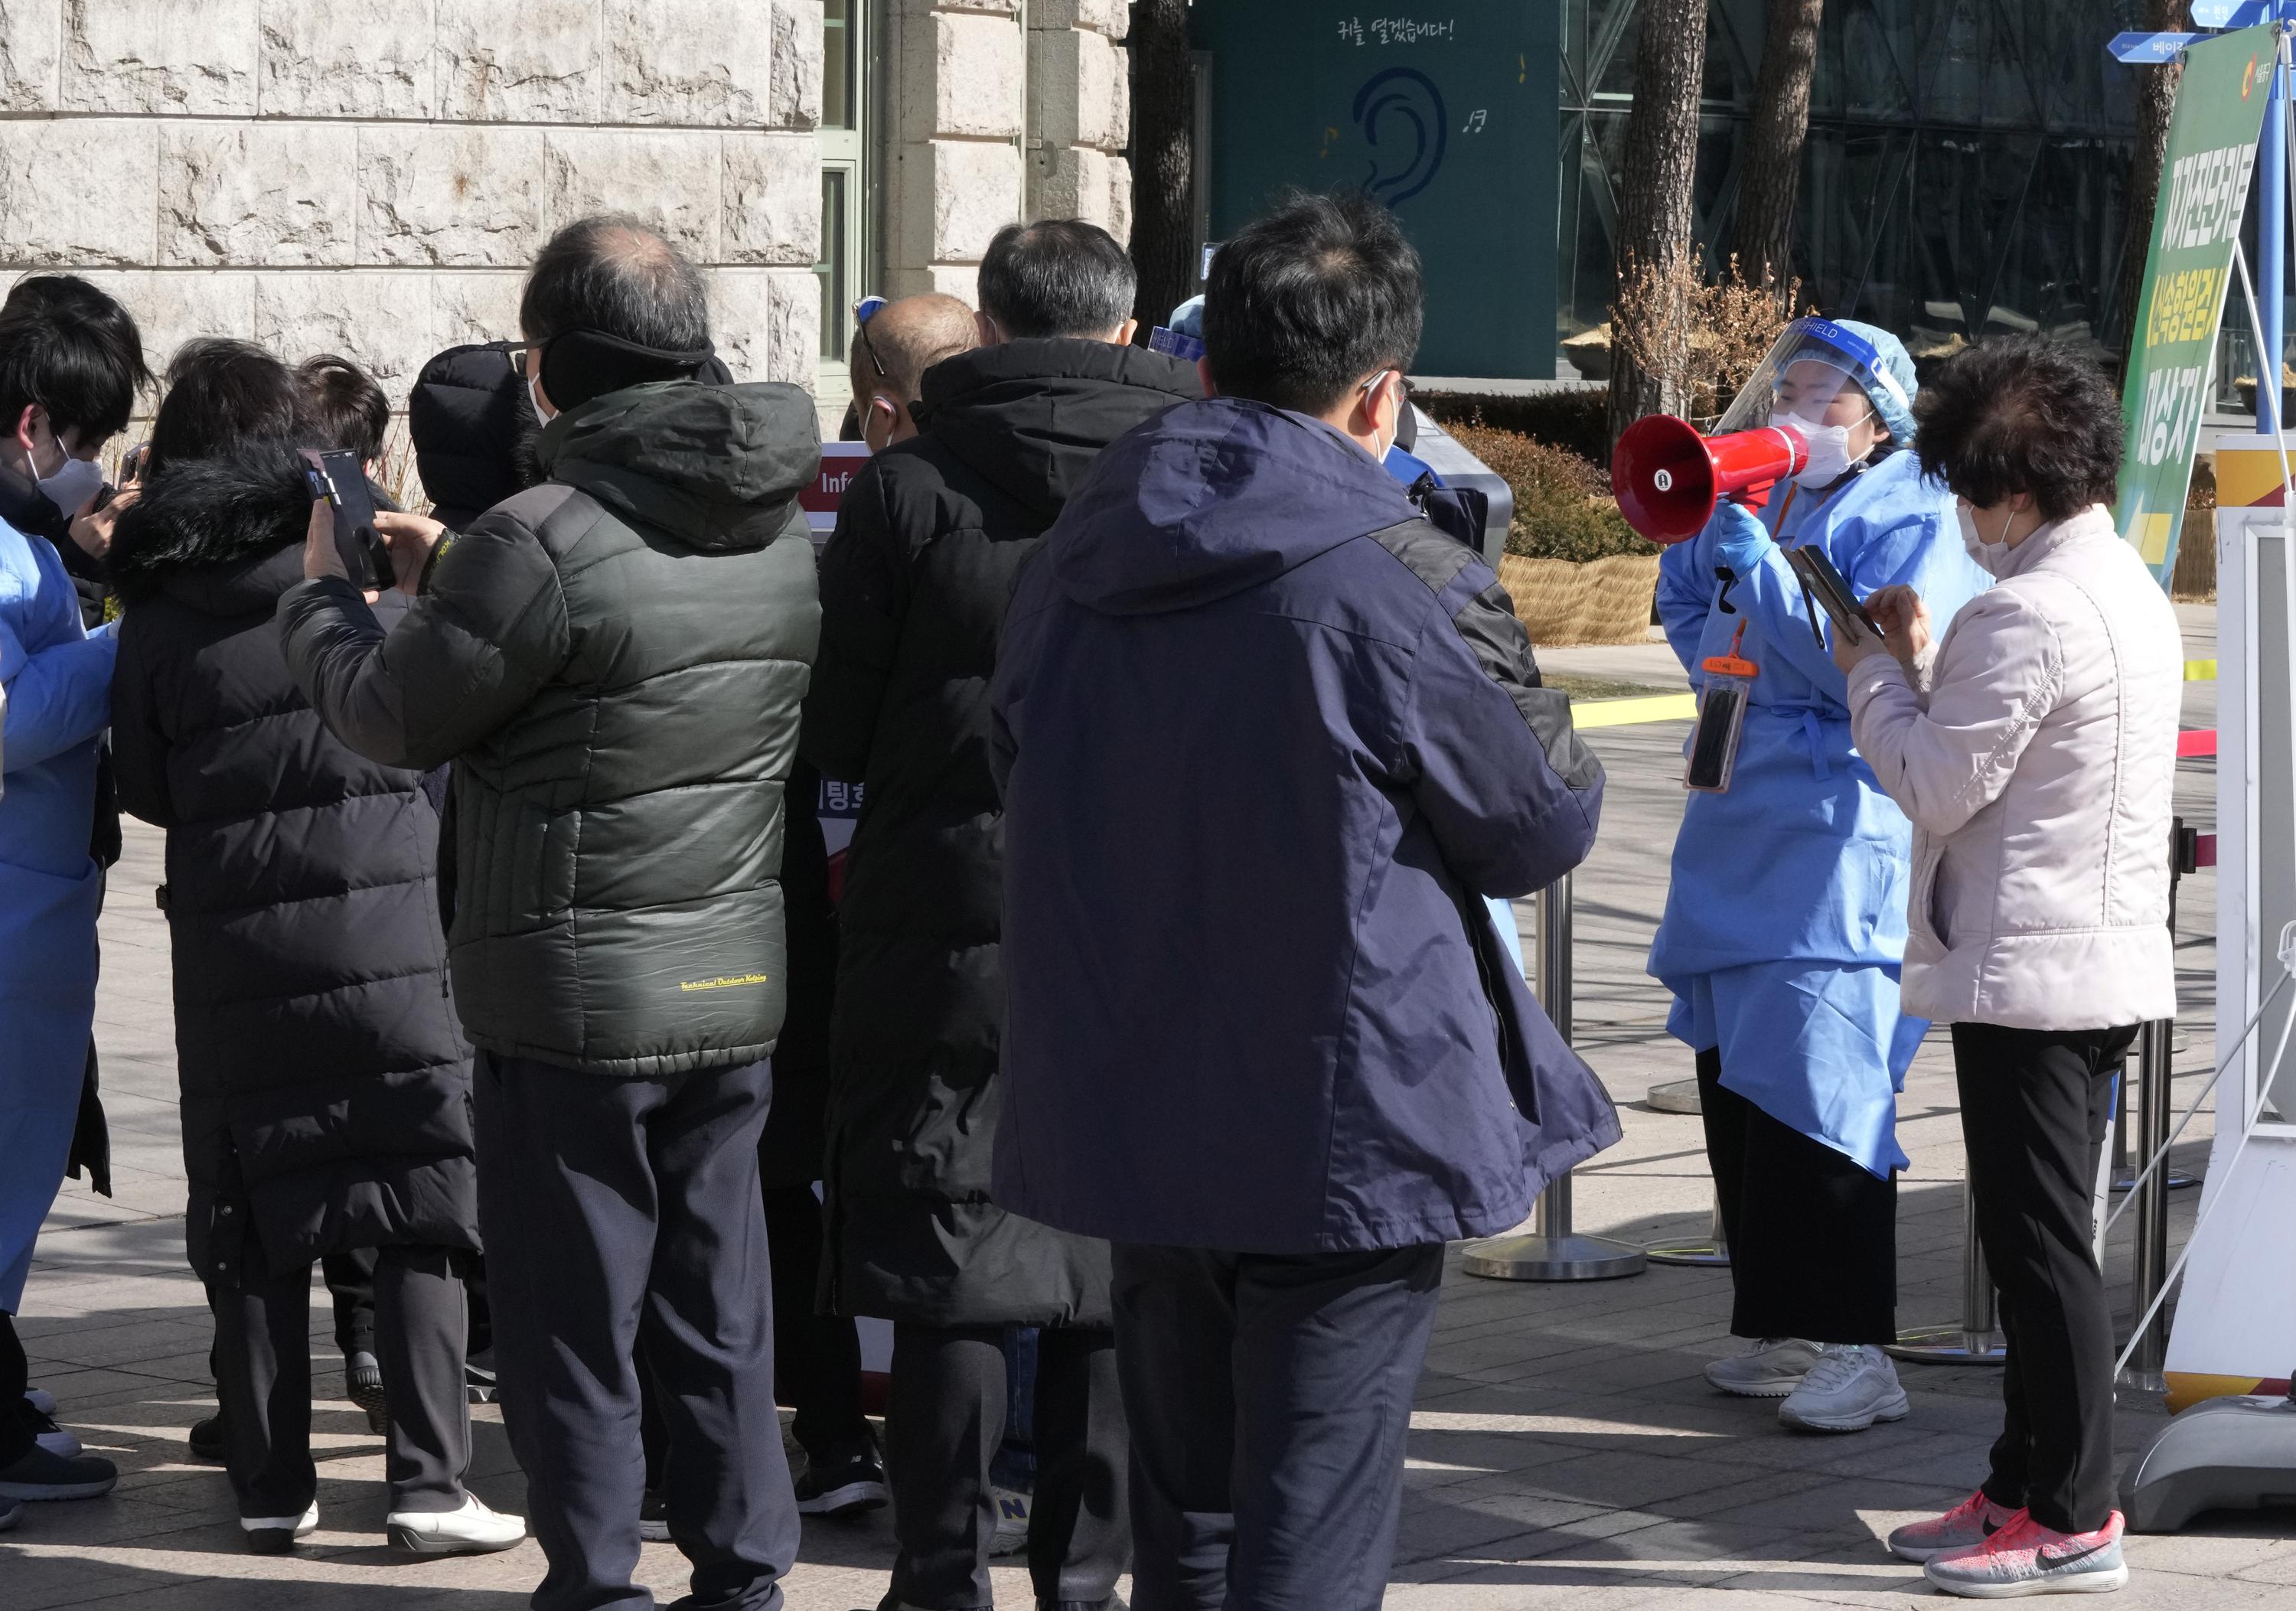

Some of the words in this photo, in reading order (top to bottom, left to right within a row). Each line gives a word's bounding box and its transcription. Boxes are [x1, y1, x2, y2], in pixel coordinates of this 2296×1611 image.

[1338, 17, 1365, 46] 귀를
[1371, 18, 1454, 44] 열겠습니다!
[2161, 143, 2255, 252] 자가진단키트
[2137, 366, 2202, 466] 대상자
[822, 471, 853, 493] Inf
